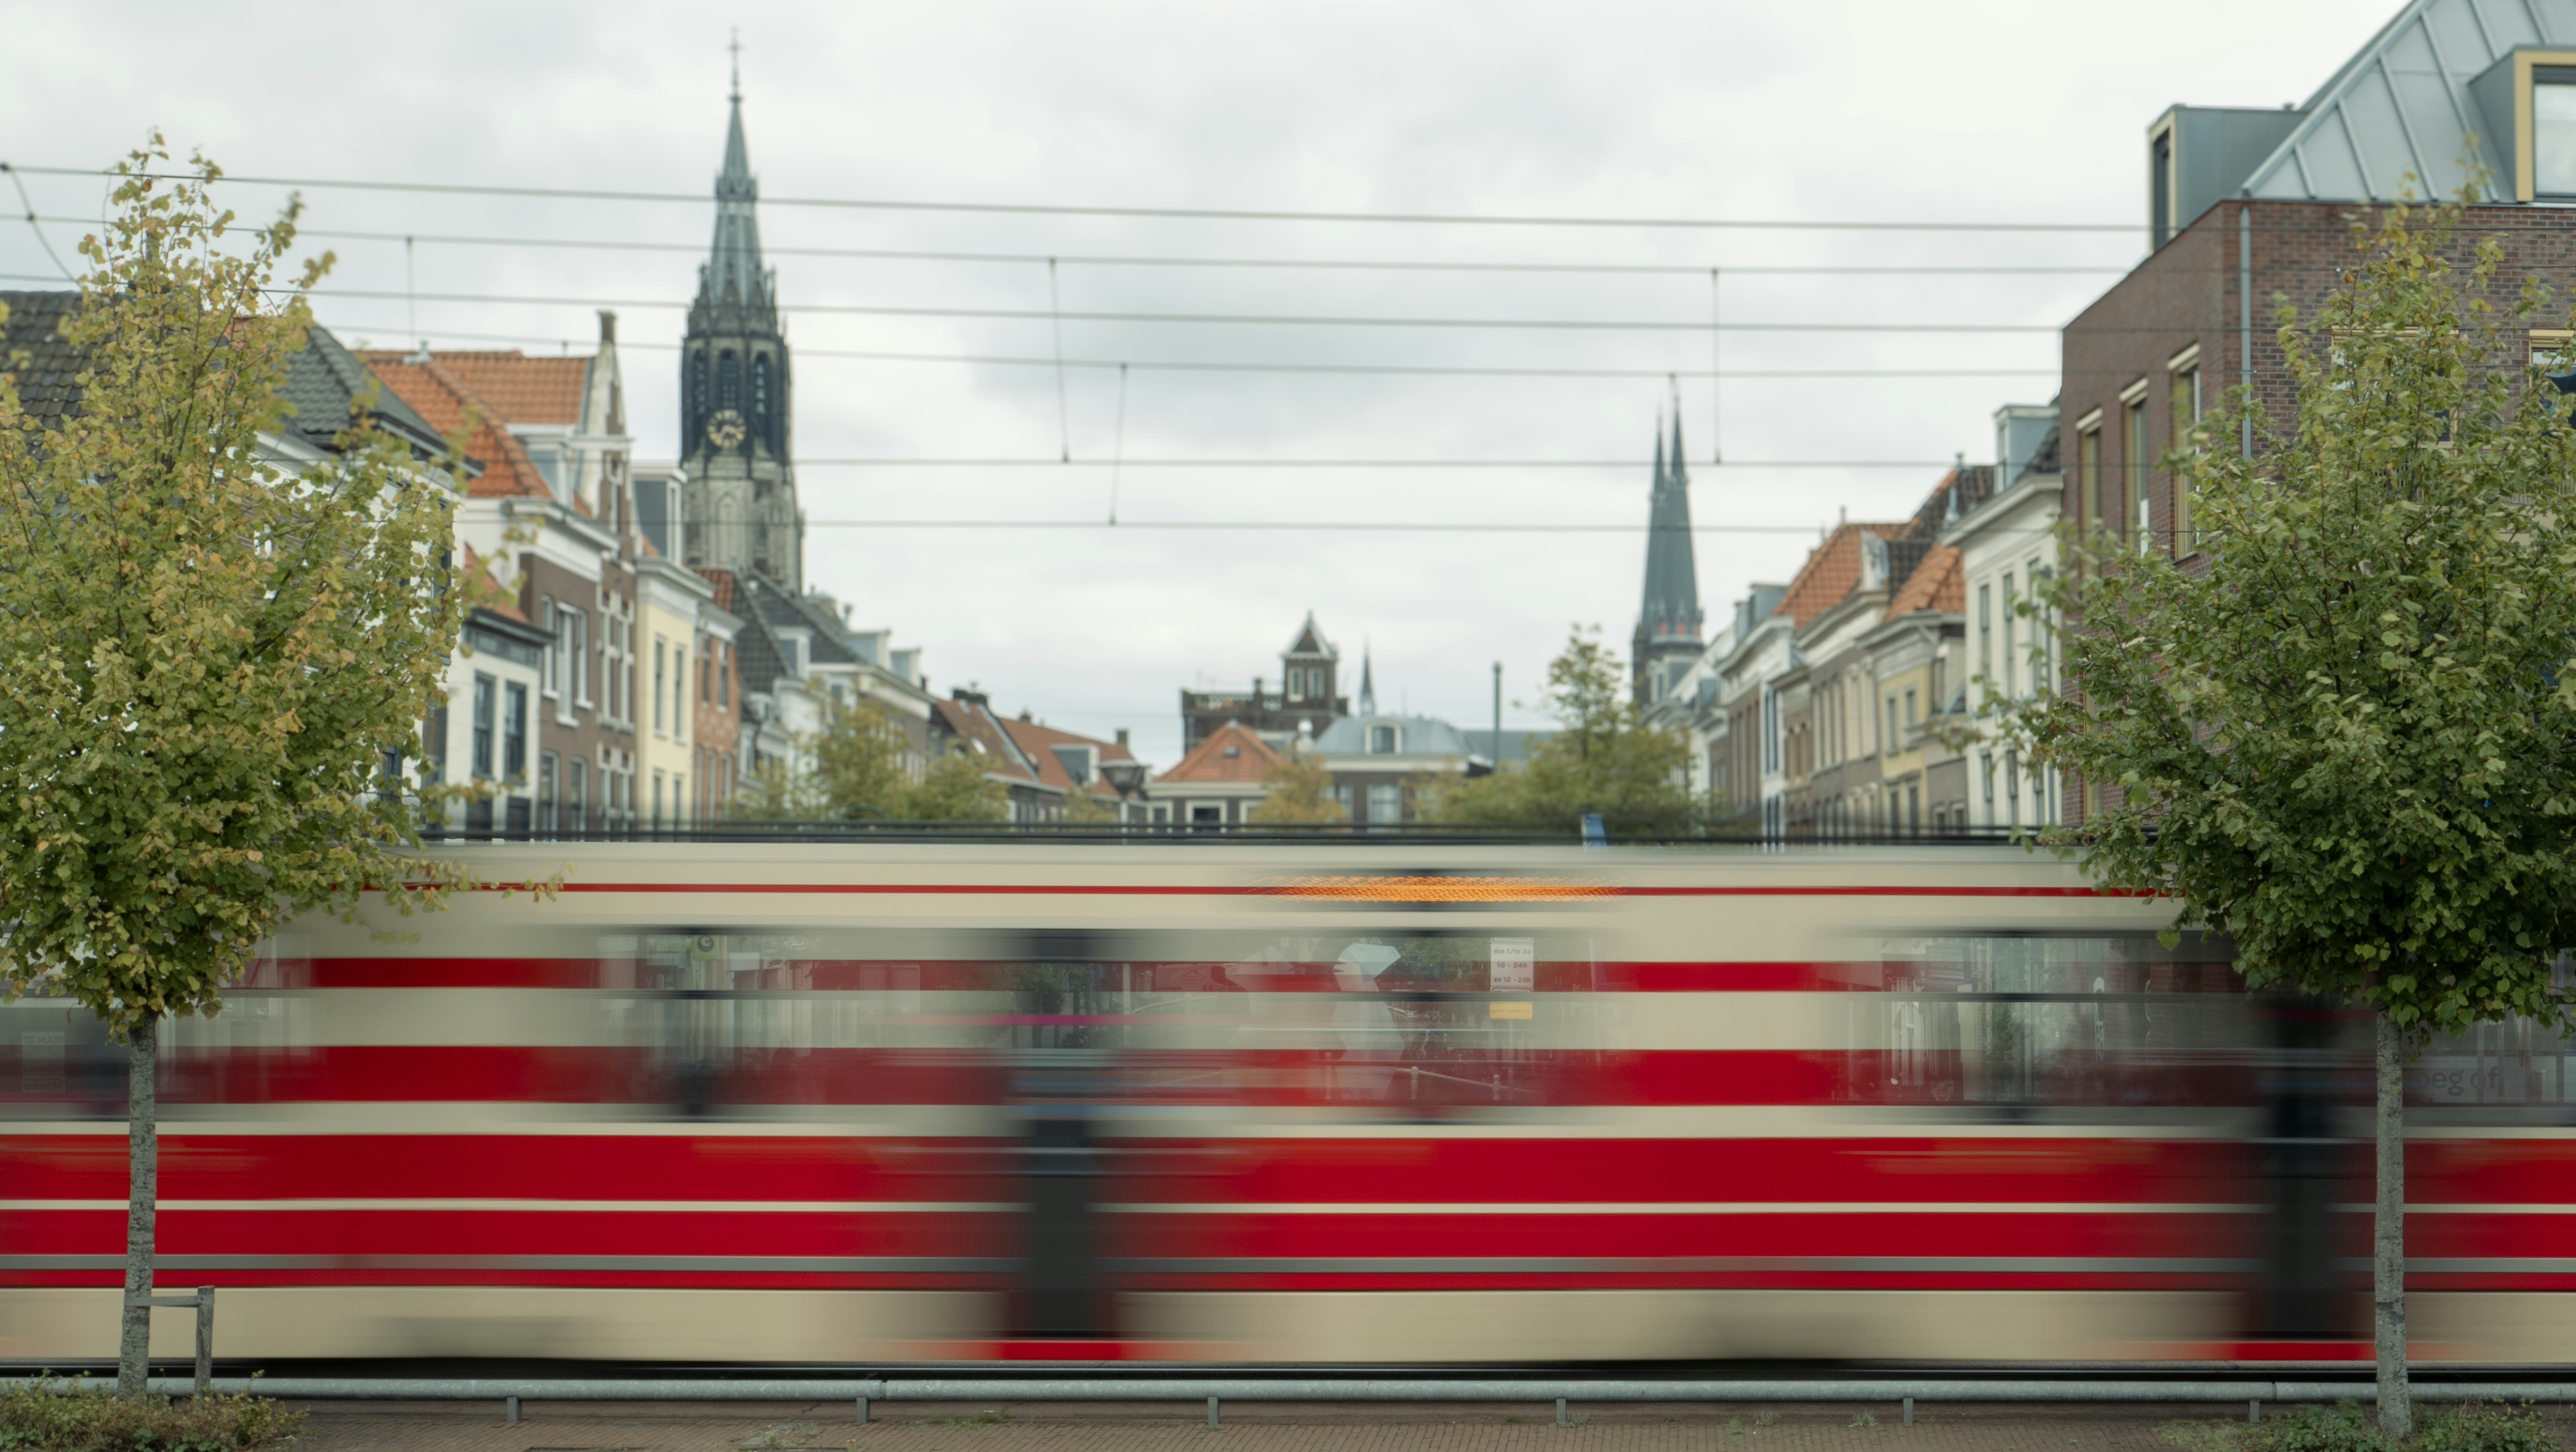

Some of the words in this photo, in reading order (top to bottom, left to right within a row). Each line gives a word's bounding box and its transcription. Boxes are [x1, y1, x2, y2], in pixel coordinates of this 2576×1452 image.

[23, 1035, 35, 1044] TE
[38, 1035, 63, 1044] HUUR
[2470, 1066, 2499, 1089] of
